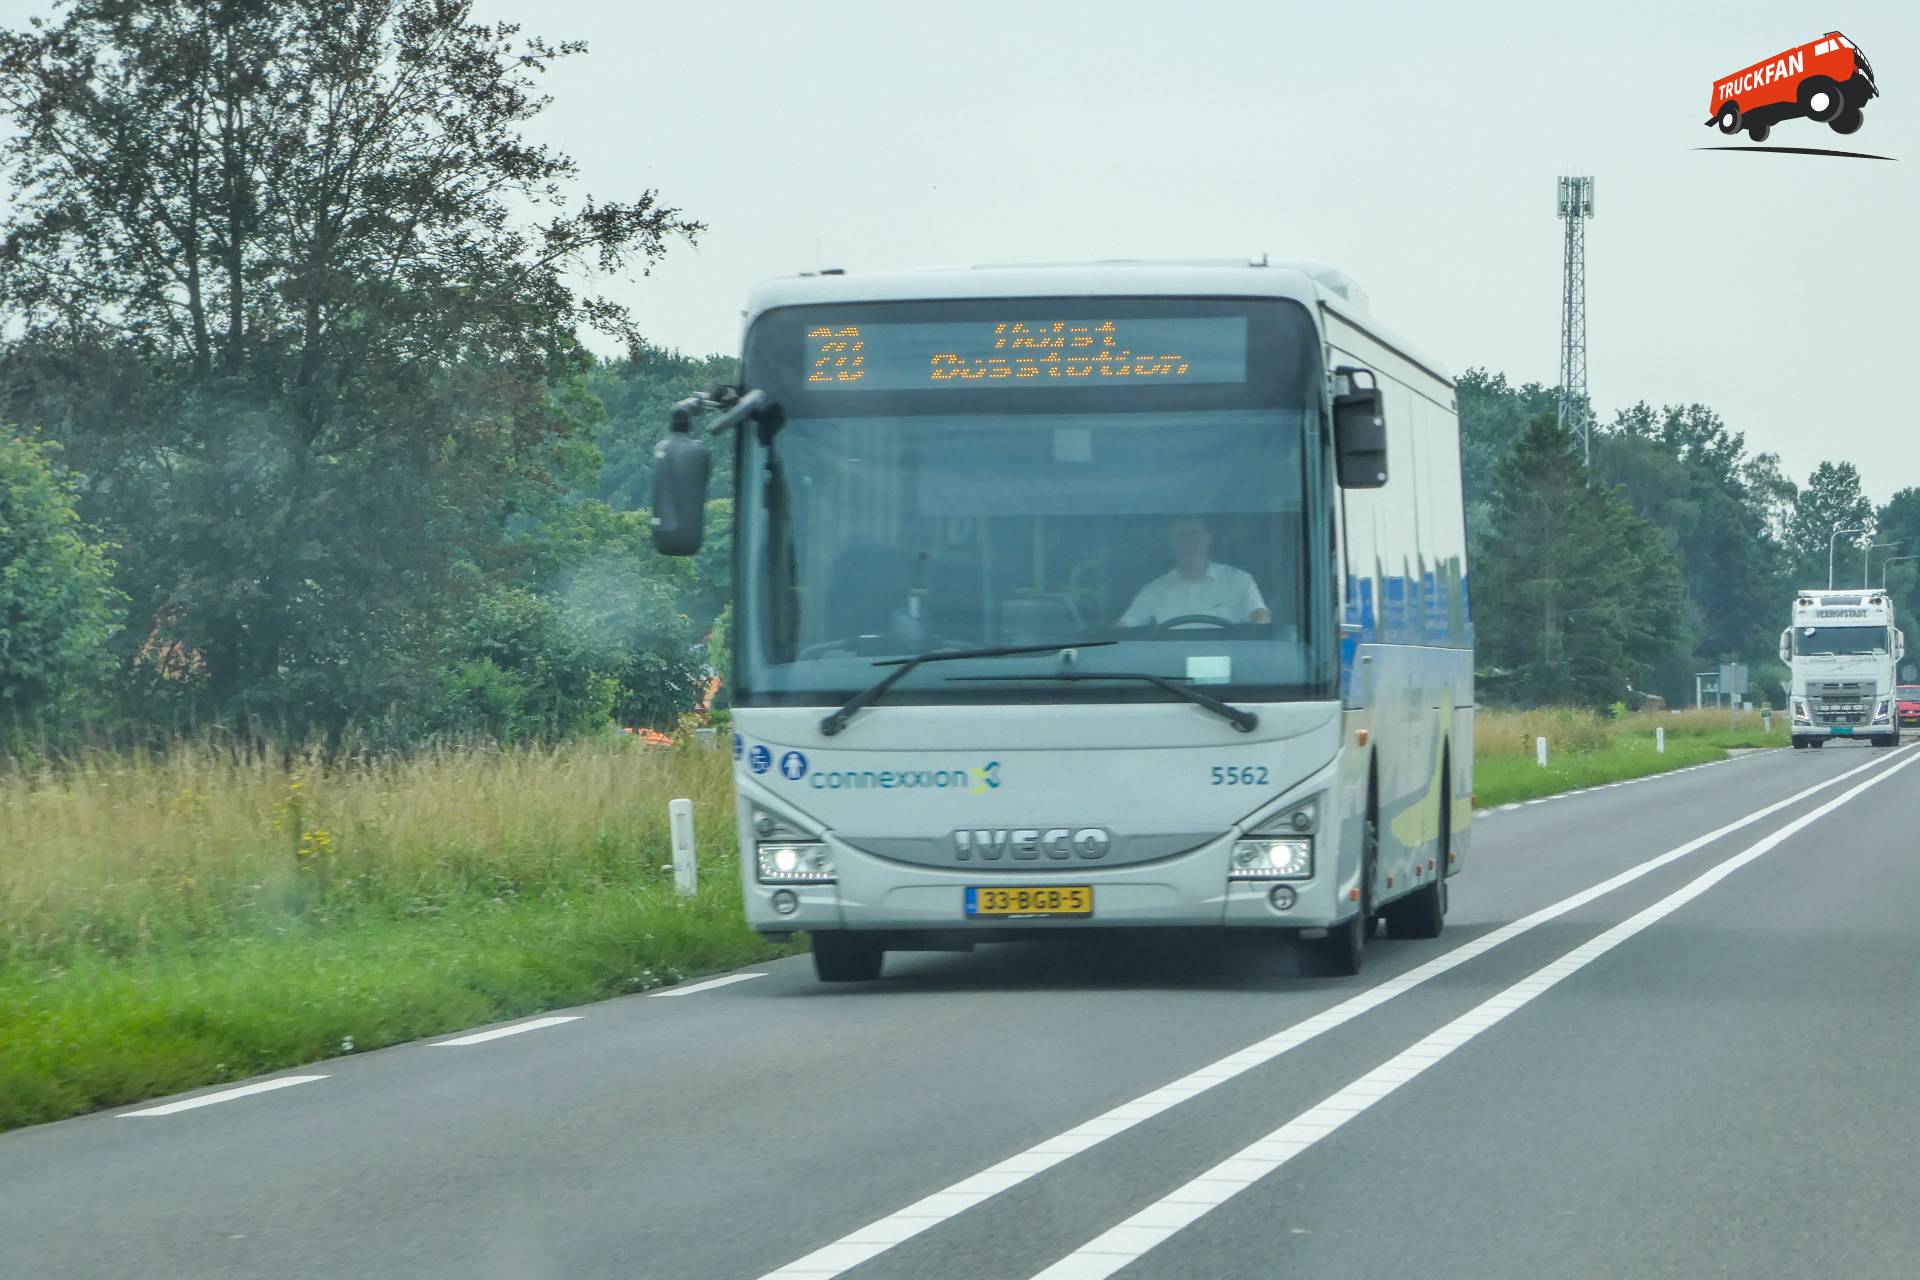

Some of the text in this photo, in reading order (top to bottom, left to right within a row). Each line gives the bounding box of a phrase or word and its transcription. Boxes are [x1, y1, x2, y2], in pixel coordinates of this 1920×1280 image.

[807, 326, 865, 381] 20
[809, 770, 969, 790] connexxion
[1210, 766, 1270, 786] 5562
[953, 827, 1110, 861] IVECO
[983, 890, 1083, 911] 33-BGB-5
